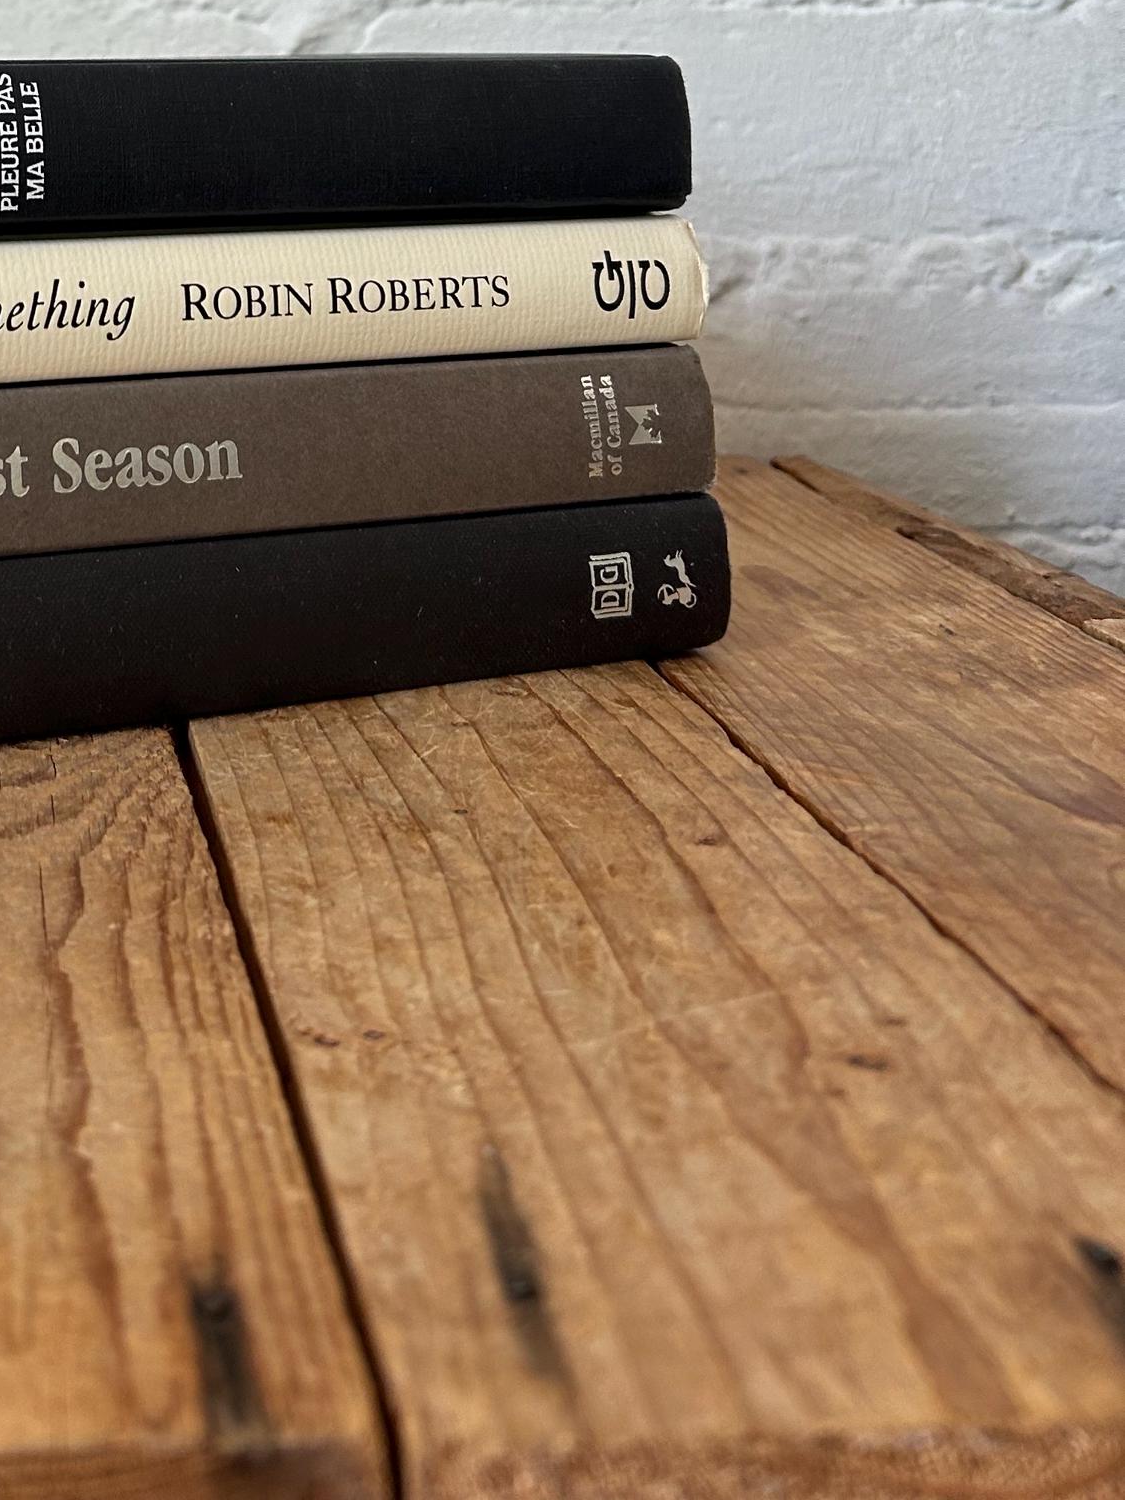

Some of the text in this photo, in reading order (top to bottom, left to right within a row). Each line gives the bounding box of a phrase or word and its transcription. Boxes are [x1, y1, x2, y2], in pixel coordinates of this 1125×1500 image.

[20, 82, 45, 200] MA BELLE
[181, 275, 510, 321] ROBIN ROBERTS
[53, 438, 243, 494] Season
[581, 375, 603, 478] Macmillan
[600, 375, 623, 476] of Canada
